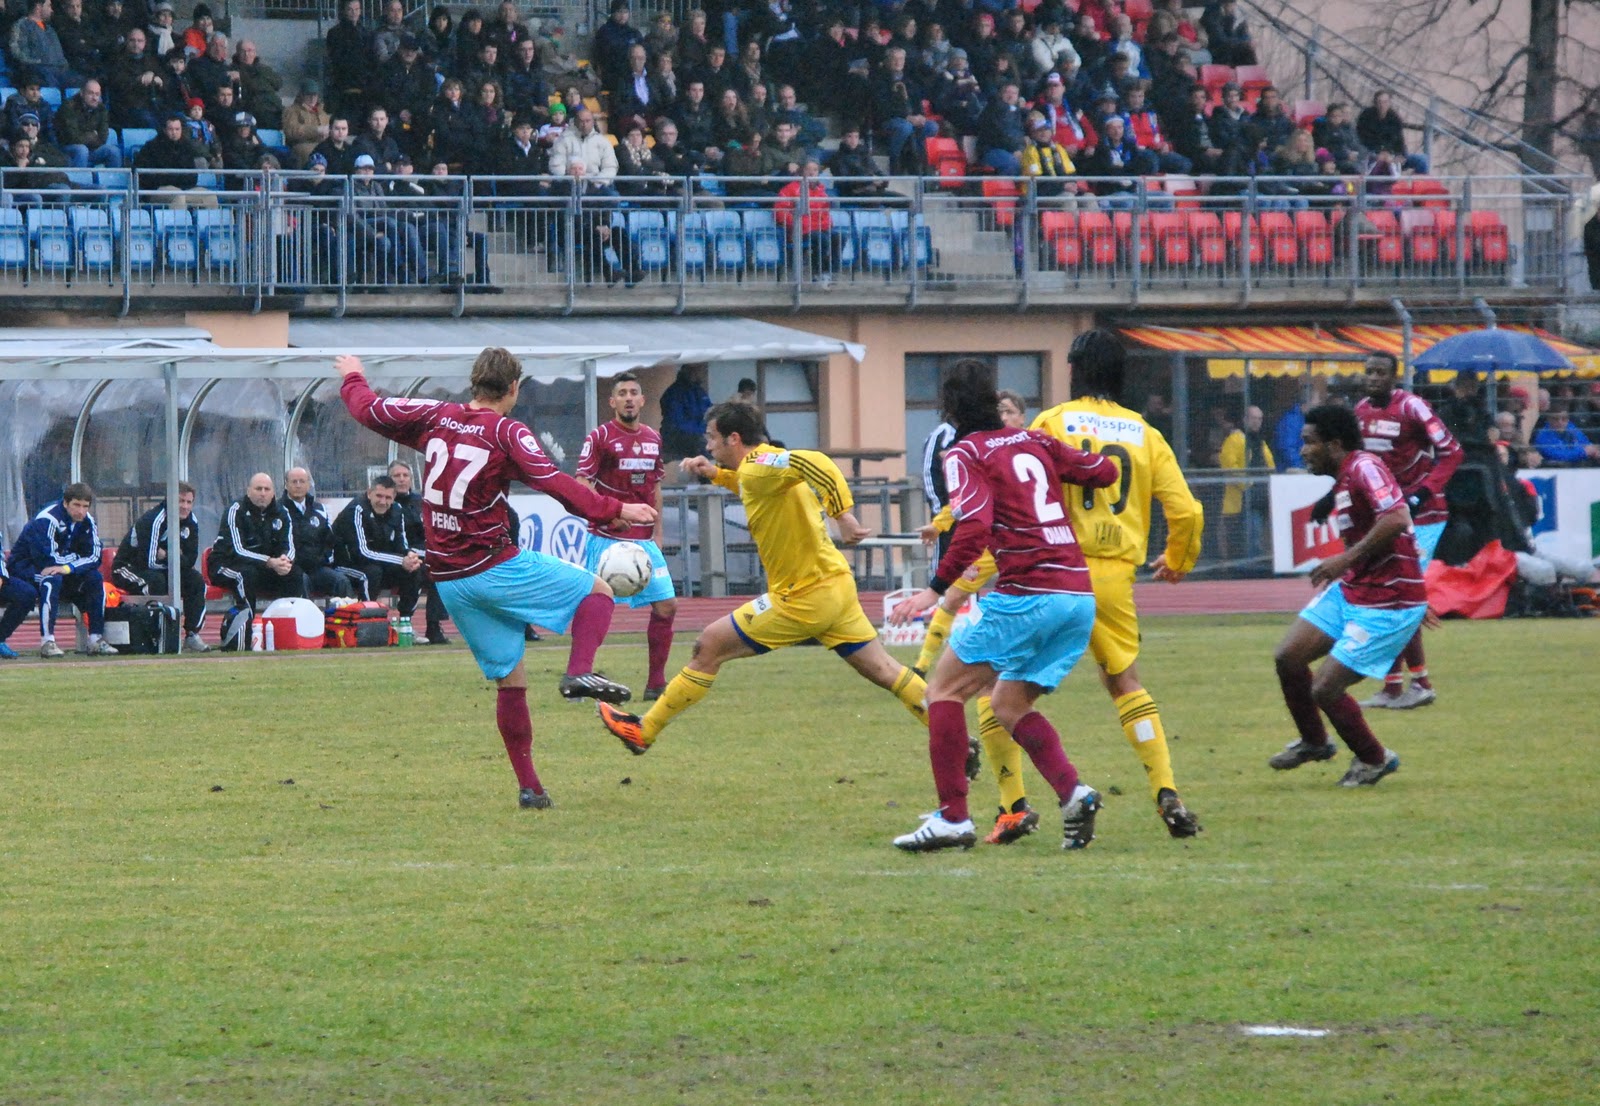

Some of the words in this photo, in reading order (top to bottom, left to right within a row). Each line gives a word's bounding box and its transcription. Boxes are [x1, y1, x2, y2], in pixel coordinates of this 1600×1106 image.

[423, 438, 491, 510] 27
[1012, 453, 1065, 523] 2
[431, 510, 461, 532] PERGL
